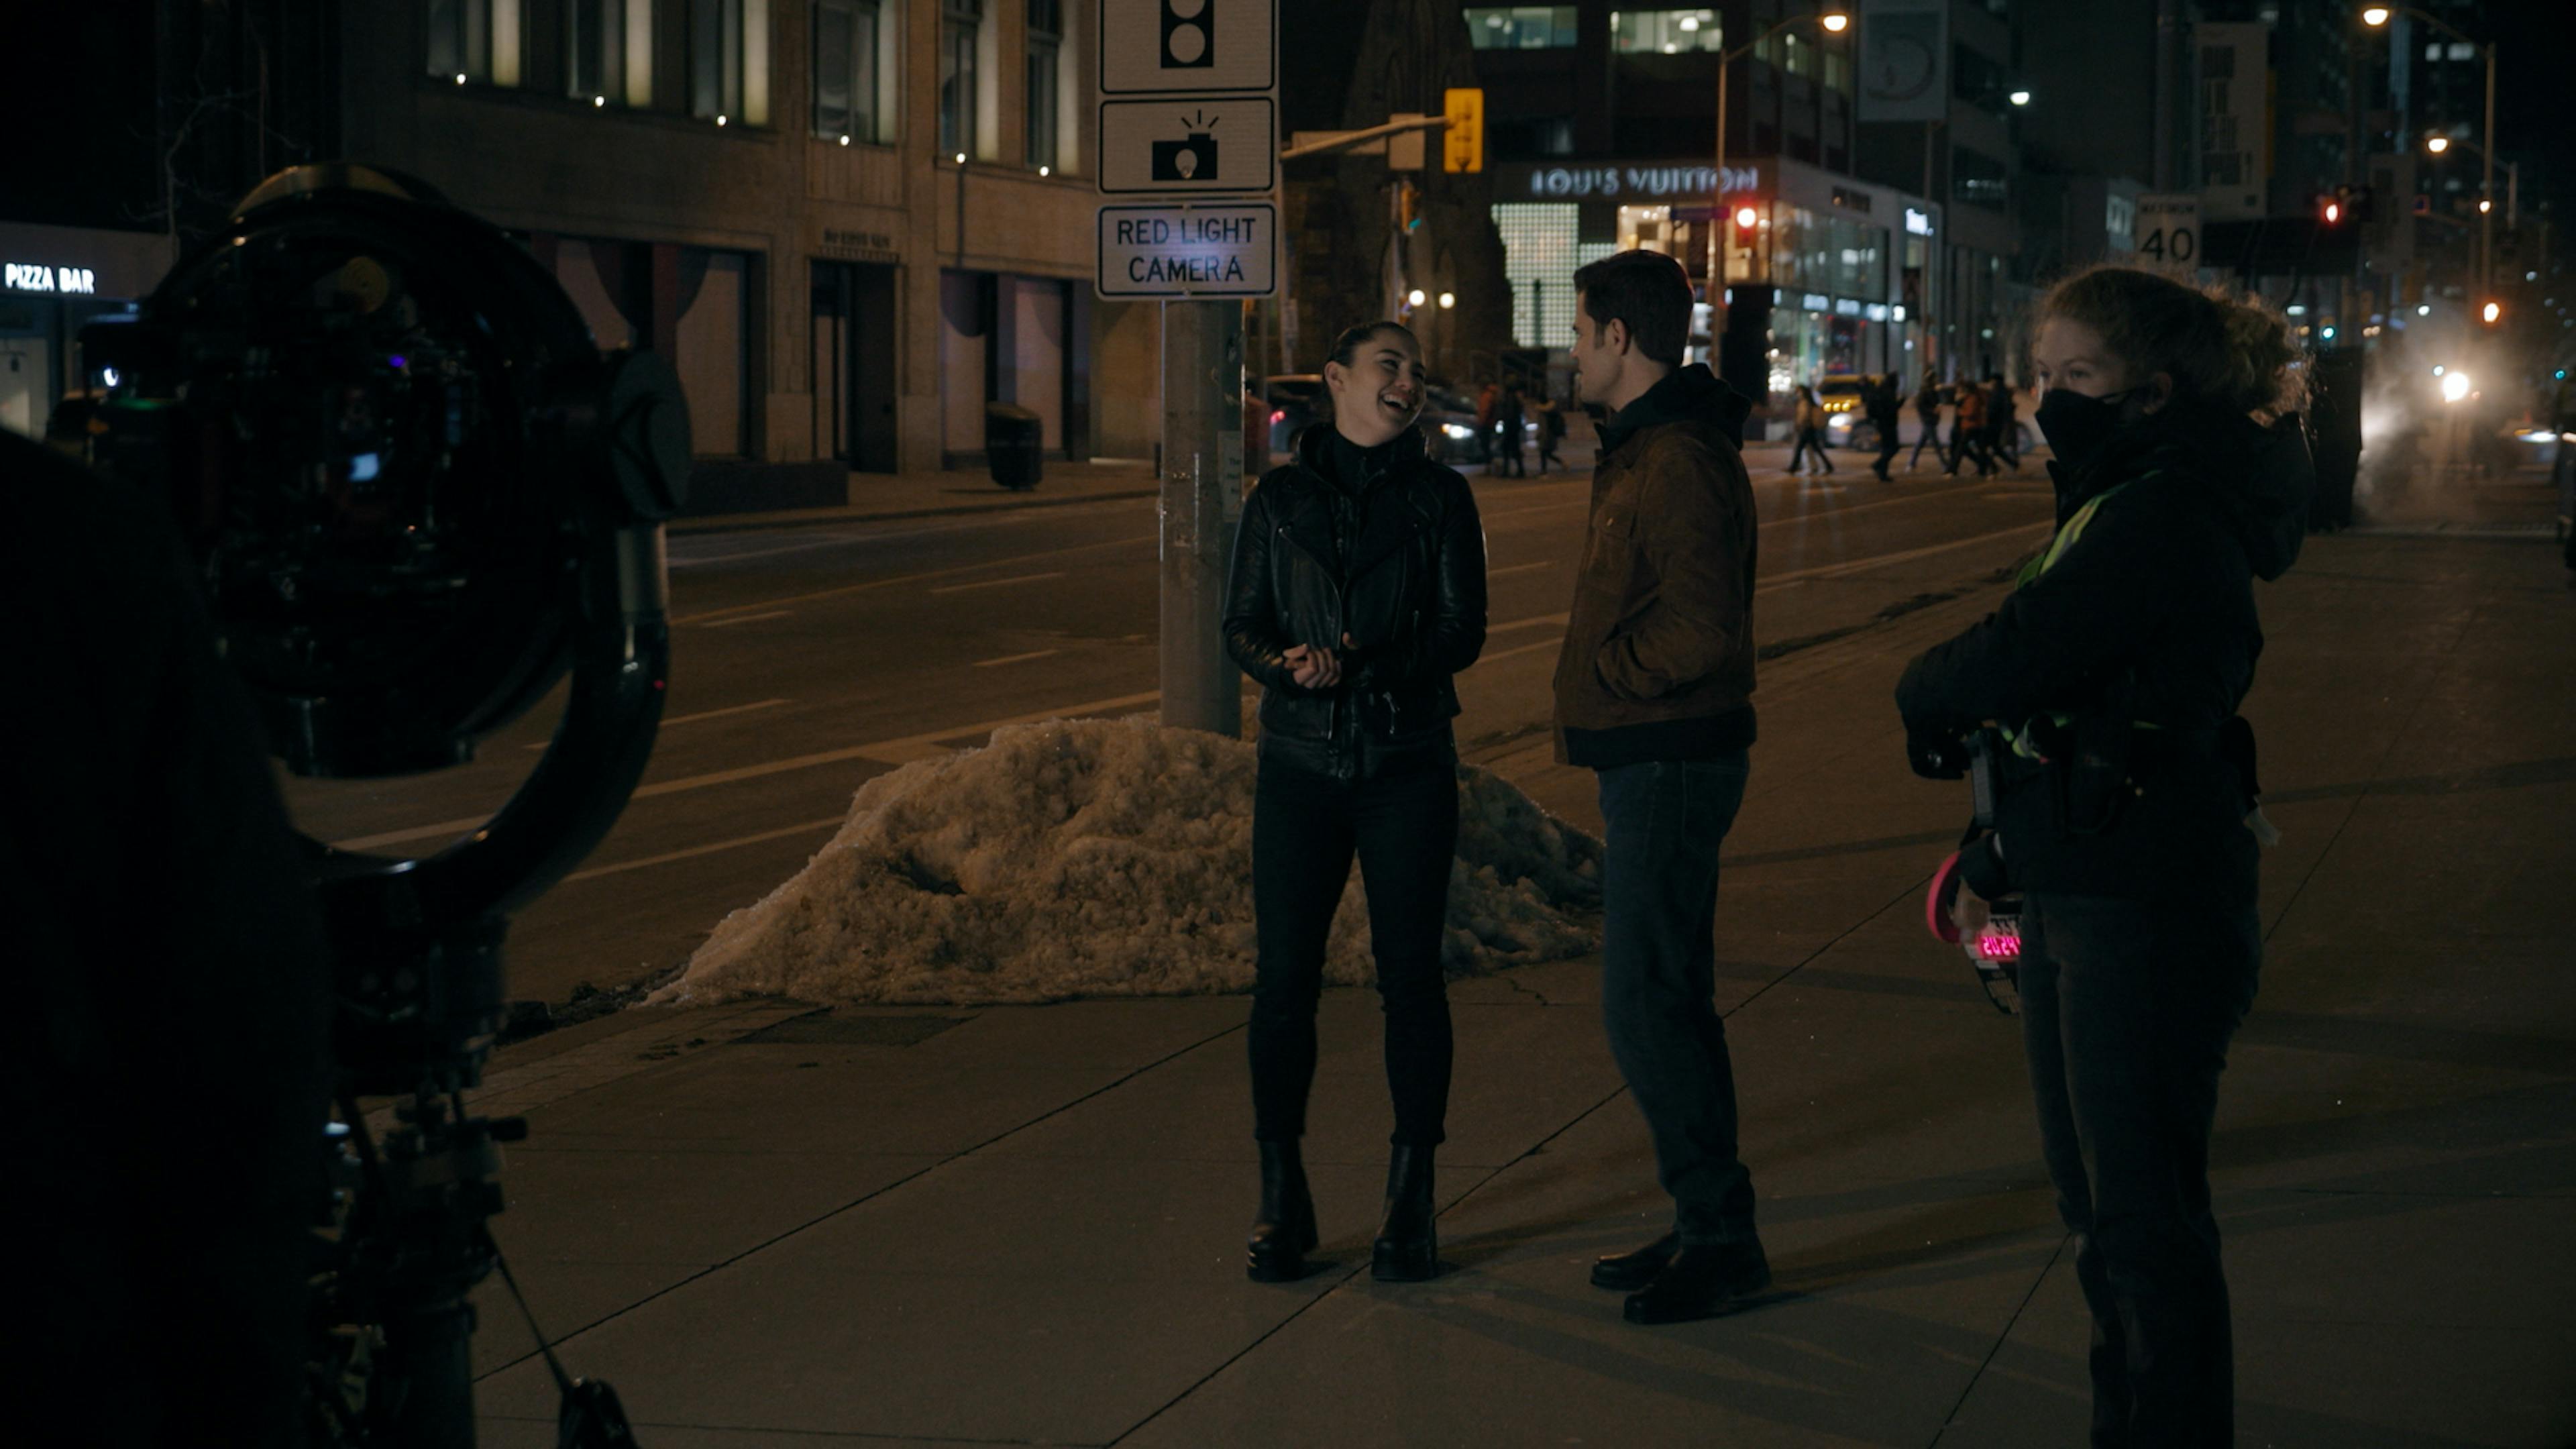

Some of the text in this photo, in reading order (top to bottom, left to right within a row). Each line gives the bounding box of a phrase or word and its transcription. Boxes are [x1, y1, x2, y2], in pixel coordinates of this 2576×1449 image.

[1626, 166, 1759, 195] VUITTON
[1118, 218, 1256, 245] RED LIGHT
[2141, 228, 2193, 262] 40
[4, 262, 95, 294] PIZZA BAR
[1130, 256, 1244, 283] CAMERA
